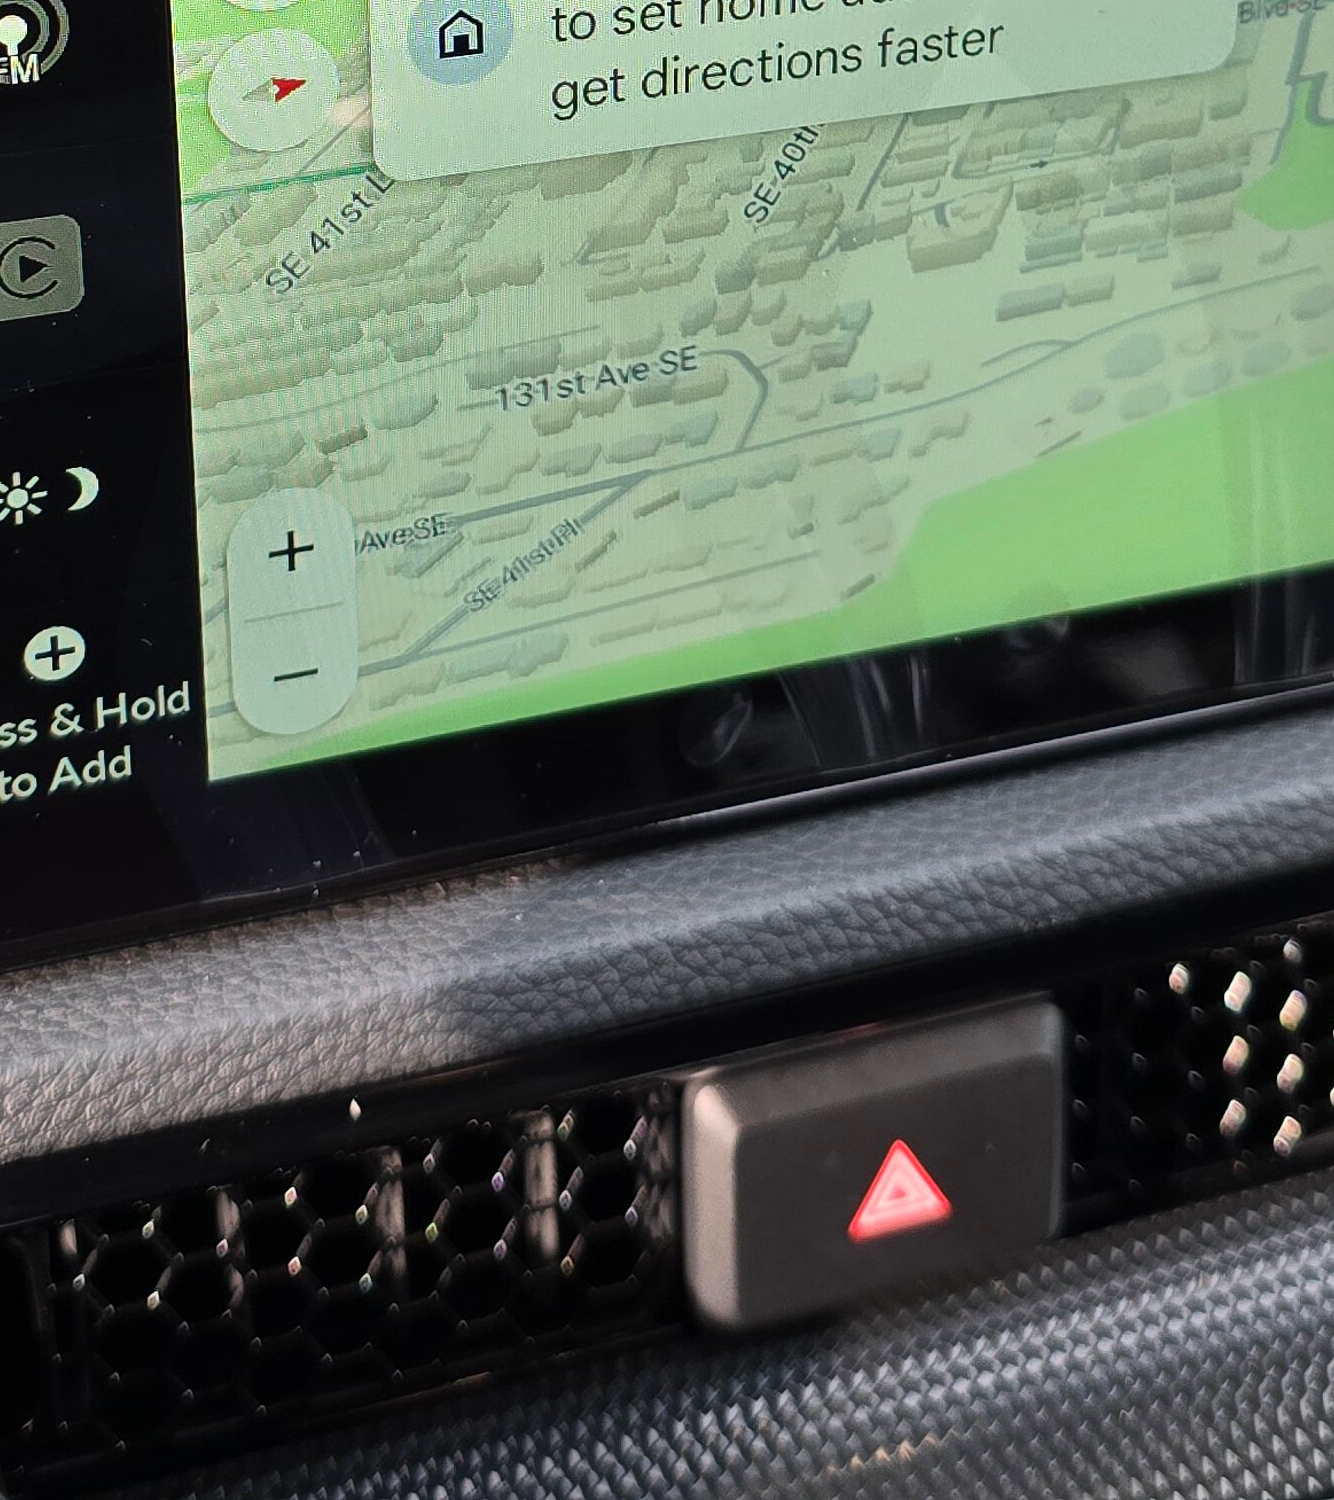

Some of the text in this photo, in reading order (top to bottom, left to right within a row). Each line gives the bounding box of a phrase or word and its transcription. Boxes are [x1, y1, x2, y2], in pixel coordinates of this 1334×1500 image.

[550, 7, 597, 43] to
[551, 25, 1005, 121] get directions faster
[744, 182, 781, 223] SE
[266, 251, 311, 294] SE
[310, 190, 374, 254] 41st
[495, 345, 698, 411] 131st Ave SE
[359, 512, 449, 554] Ave SE
[464, 577, 502, 612] SE
[50, 702, 84, 737] &
[96, 680, 191, 730] Hold
[49, 744, 132, 793] Add
